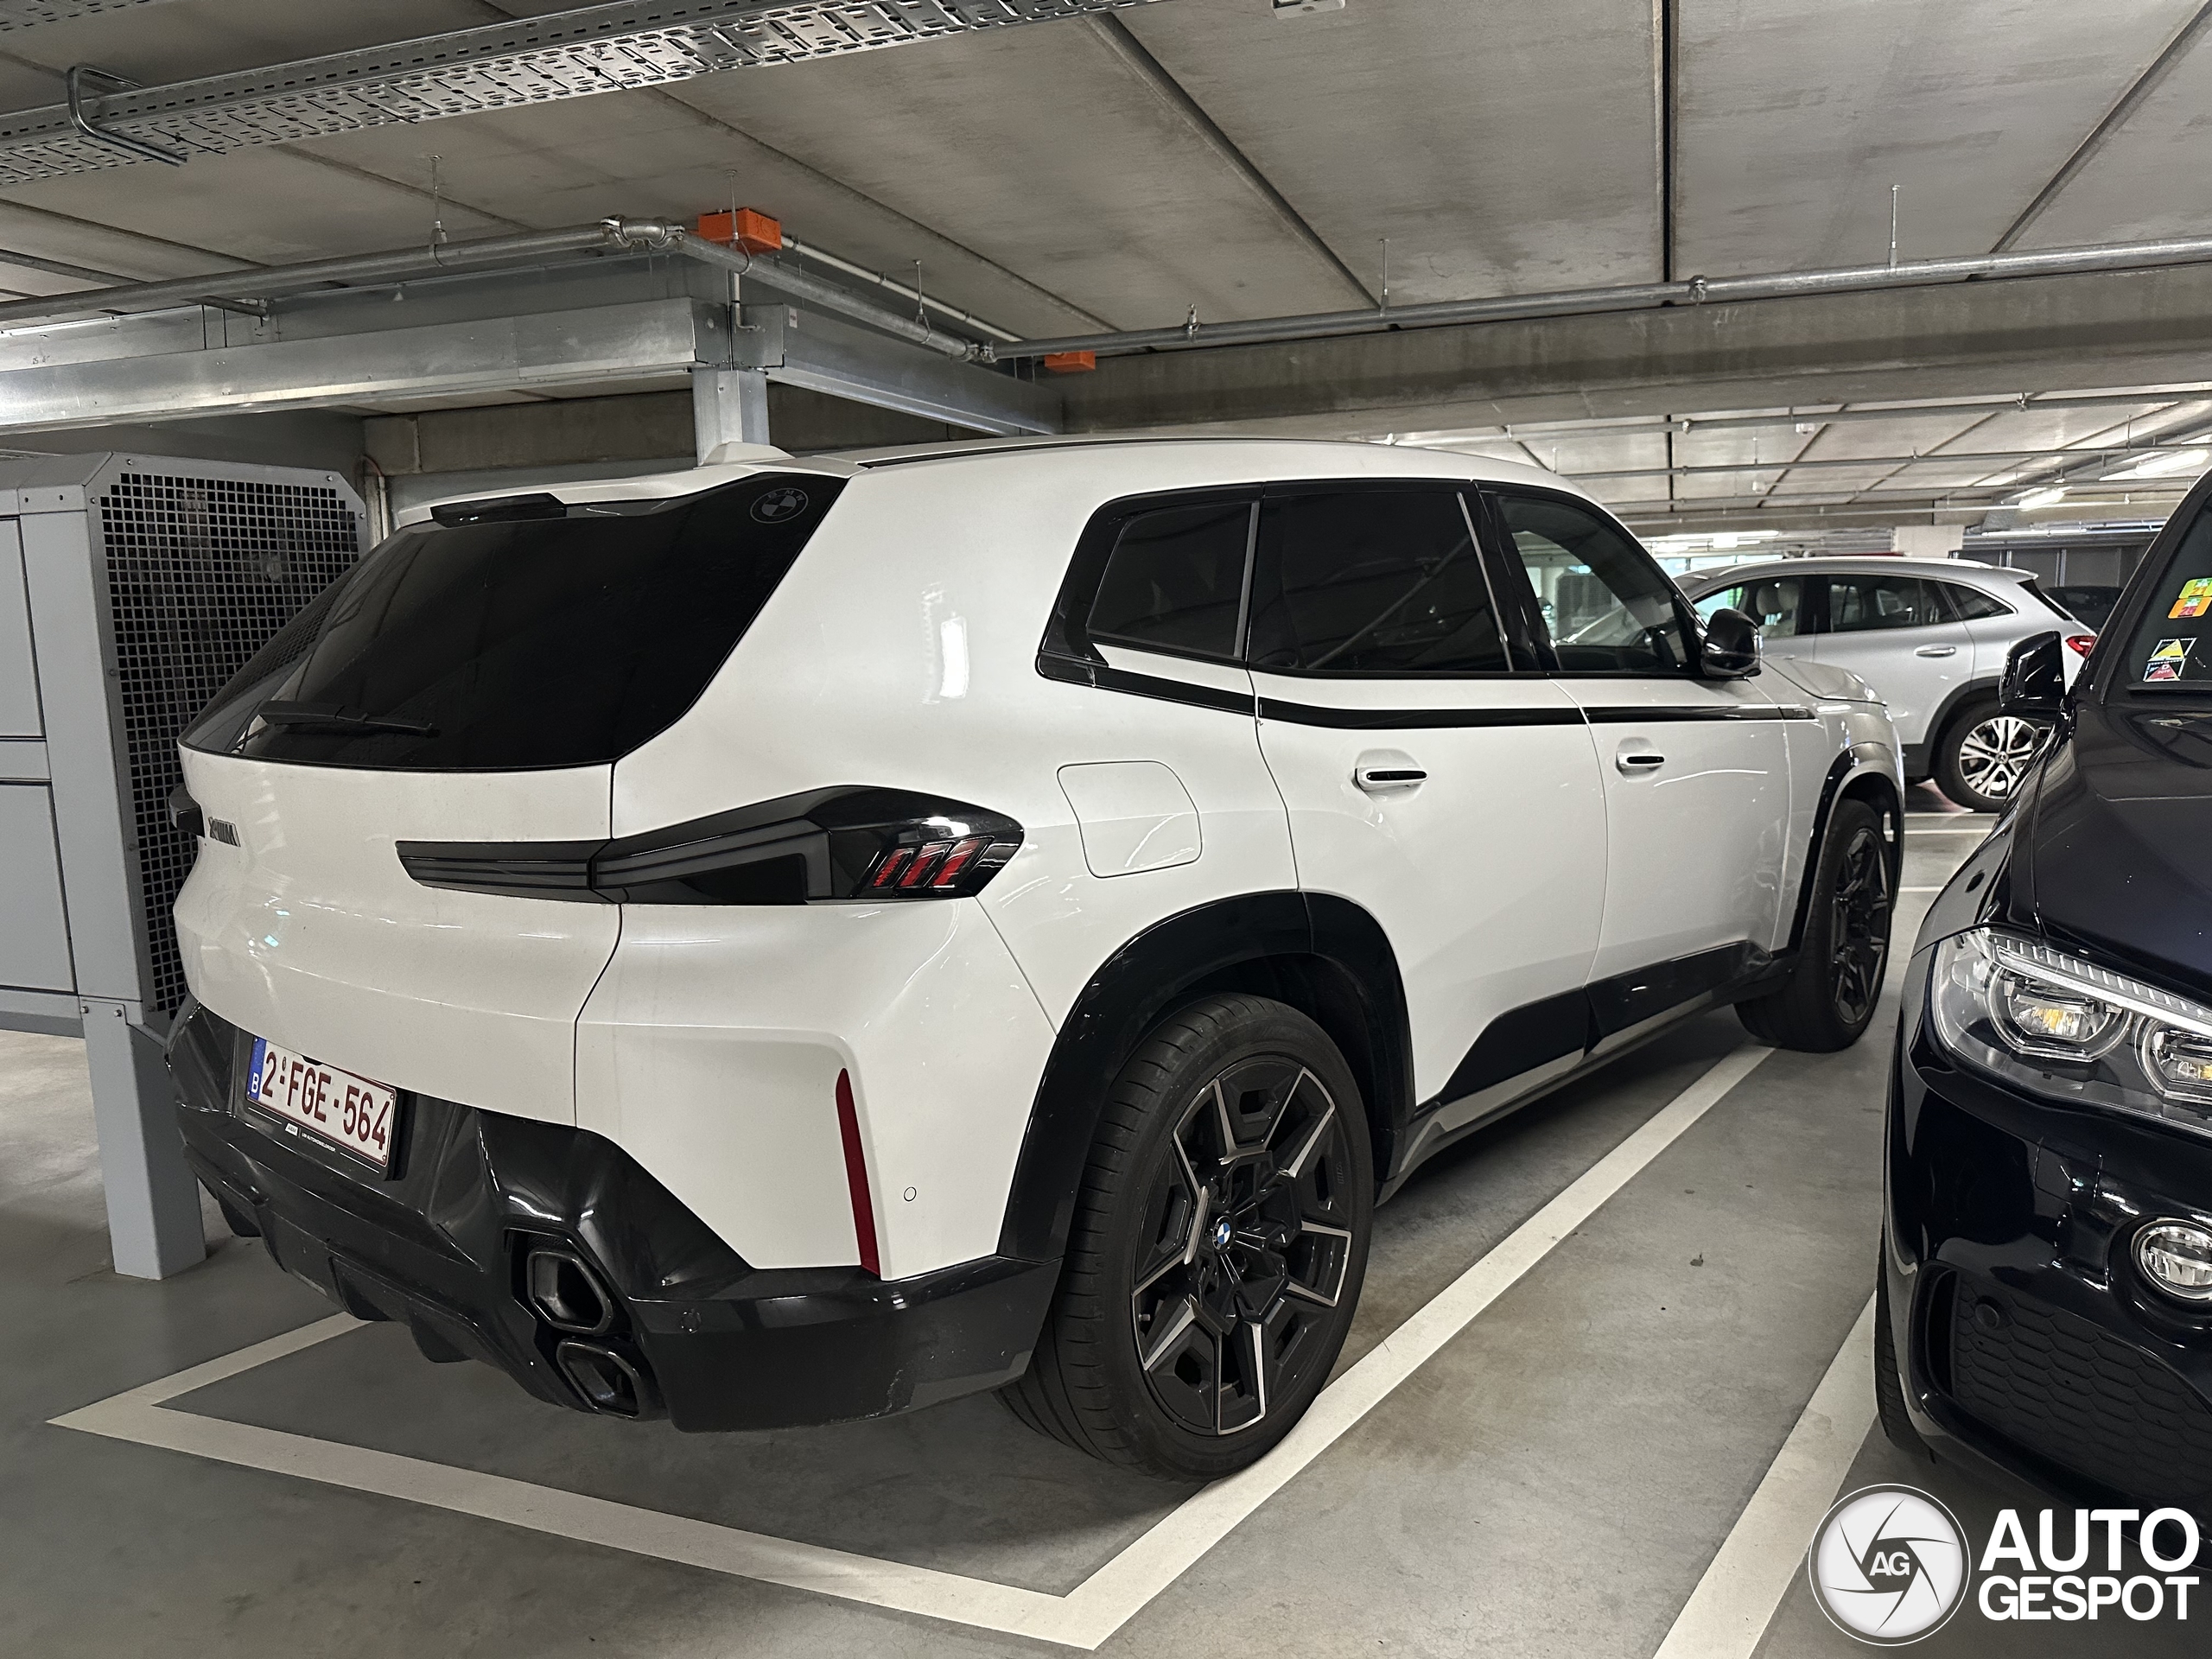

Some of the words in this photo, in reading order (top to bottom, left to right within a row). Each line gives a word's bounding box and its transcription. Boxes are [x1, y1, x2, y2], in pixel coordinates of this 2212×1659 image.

[768, 490, 804, 501] BMW
[251, 1072, 259, 1094] B
[262, 1052, 390, 1151] 2-FGE-564
